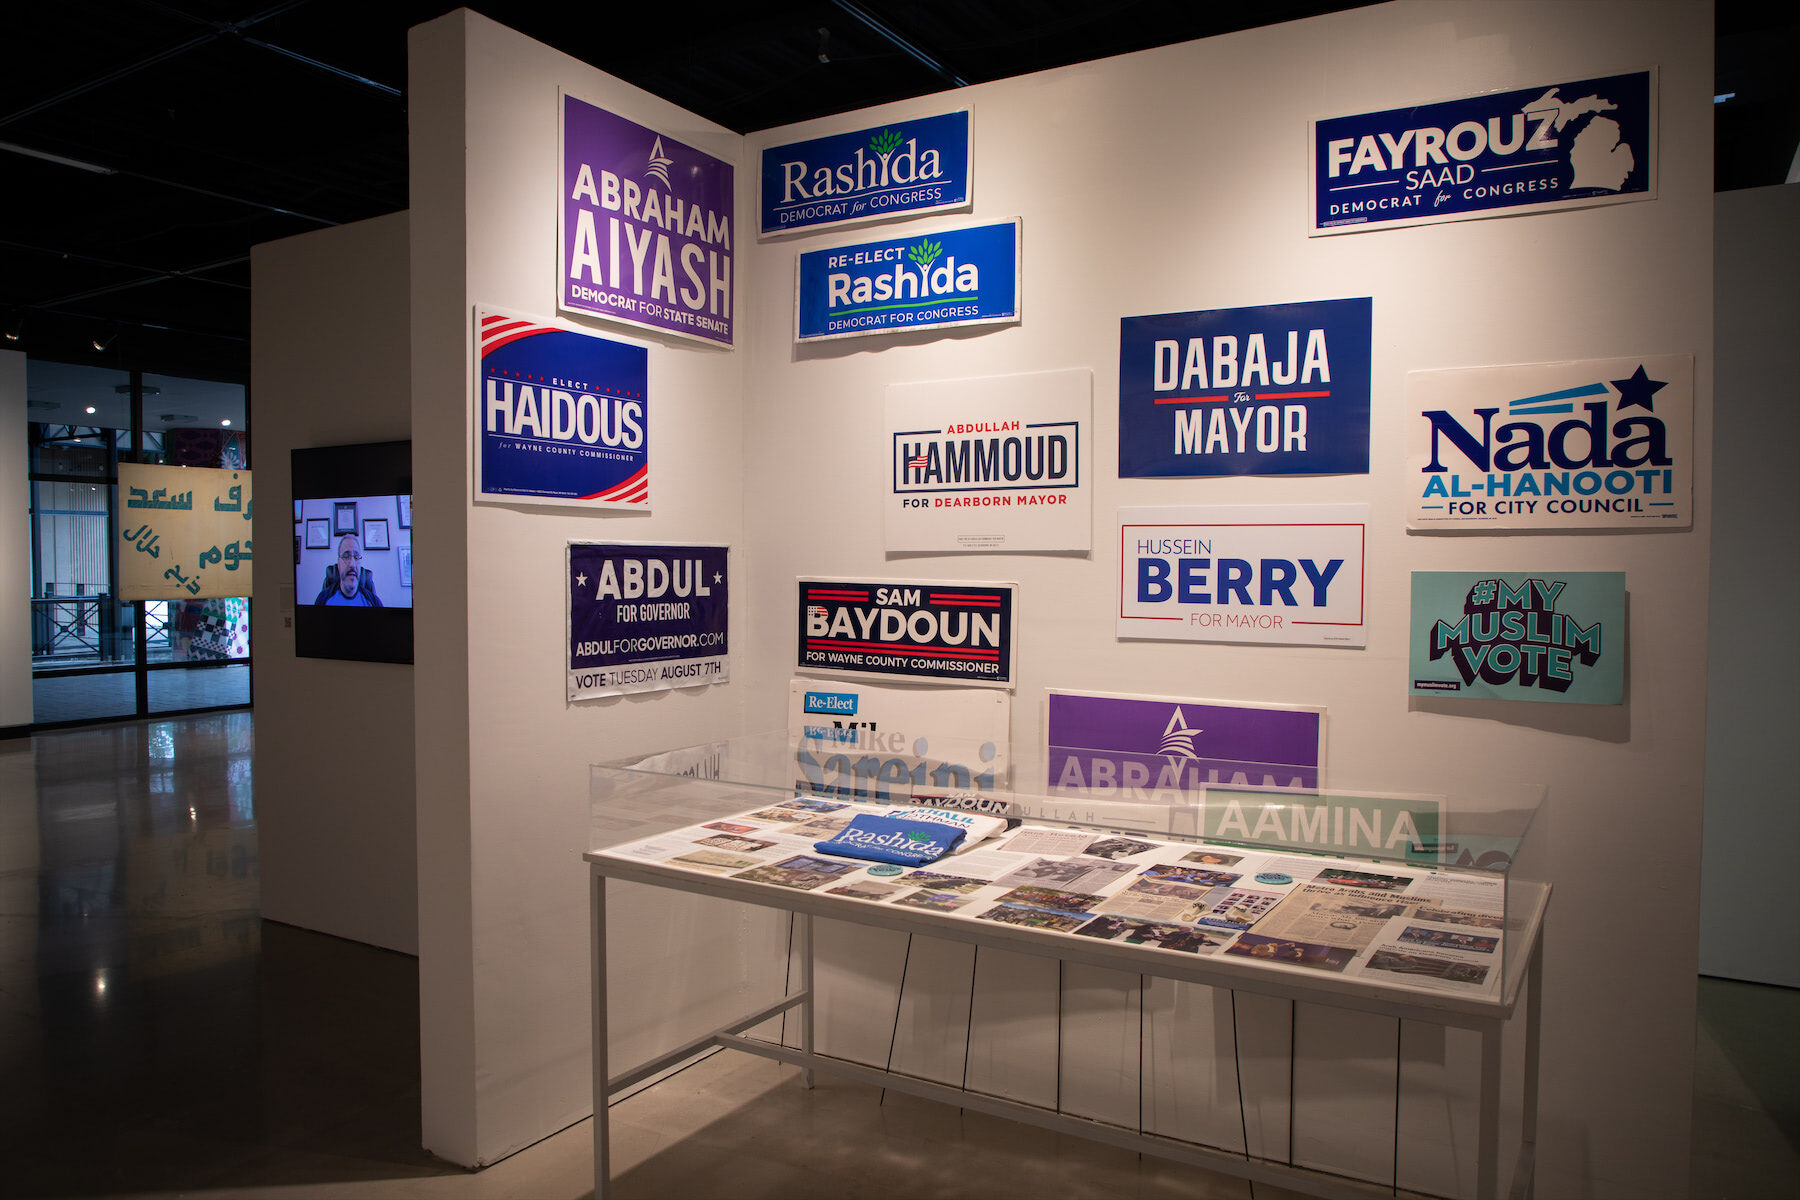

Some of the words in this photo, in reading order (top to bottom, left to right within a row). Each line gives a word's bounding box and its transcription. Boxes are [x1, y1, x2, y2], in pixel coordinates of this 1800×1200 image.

[1328, 108, 1559, 178] FAYROUZ
[1405, 164, 1475, 191] SAAD
[572, 163, 730, 251] ABRAHAM
[780, 203, 848, 224] DEMOCRAT
[850, 201, 866, 215] for
[870, 187, 941, 208] CONGRESS
[1330, 194, 1421, 216] DEMOCRAT
[1434, 190, 1451, 207] for
[1463, 177, 1558, 200] CONGRESS
[570, 208, 730, 319] AIYASH
[828, 247, 905, 269] RE-ELECT
[571, 284, 636, 312] DEMOCRAT
[640, 301, 663, 318] FOR
[663, 308, 694, 325] STATE
[696, 316, 728, 335] SENATE
[828, 319, 887, 331] DEMOCRAT
[890, 312, 913, 323] FOR
[917, 305, 978, 321] CONGRESS
[1154, 328, 1331, 392] DABAJA
[552, 377, 588, 390] ELECT
[1234, 392, 1250, 403] For
[487, 379, 643, 449] HAIDOUS
[947, 420, 1020, 434] ABDULLAH
[1175, 404, 1307, 455] MAYOR
[1422, 400, 1673, 472] Nada
[515, 443, 542, 452] WAYNE
[546, 446, 576, 456] COUNTY
[579, 449, 633, 462] COMMISSIONER
[903, 435, 1067, 485] HAMMOUD
[128, 485, 192, 510] سعد
[1422, 469, 1673, 498] AL-HANOOTI
[903, 499, 929, 508] FOR
[935, 496, 1011, 507] DEARBORN
[1017, 494, 1067, 506] MAYOR
[1448, 501, 1487, 515] FOR
[1495, 500, 1538, 514] CITY
[1546, 498, 1643, 513] COUNCIL
[1138, 539, 1211, 554] HUSSEIN
[596, 559, 710, 600] ABDUL
[1137, 557, 1345, 607] BERRY
[876, 587, 921, 607] SAM
[1466, 579, 1567, 613] #MY
[617, 604, 637, 623] FOR
[640, 602, 690, 622] GOVERNOR
[806, 605, 1000, 647] BAYDOUN
[1191, 613, 1222, 627] FOR
[1226, 614, 1283, 629] MAYOR
[576, 632, 723, 657] ABDULFORGOVERNOR.COM
[1430, 611, 1601, 667] MUSLIM
[576, 673, 606, 689] VOTE
[609, 668, 658, 685] TUESDAY
[661, 664, 701, 679] AUGUST
[704, 662, 721, 674] 7TH
[806, 651, 825, 662] FOR
[828, 653, 863, 665] WAYNE
[866, 655, 908, 668] COUNTY
[911, 659, 999, 674] COMMISSIONER
[1453, 644, 1573, 692] VOTE
[809, 695, 853, 710] Re-Elect
[1216, 799, 1424, 852] AAMINA
